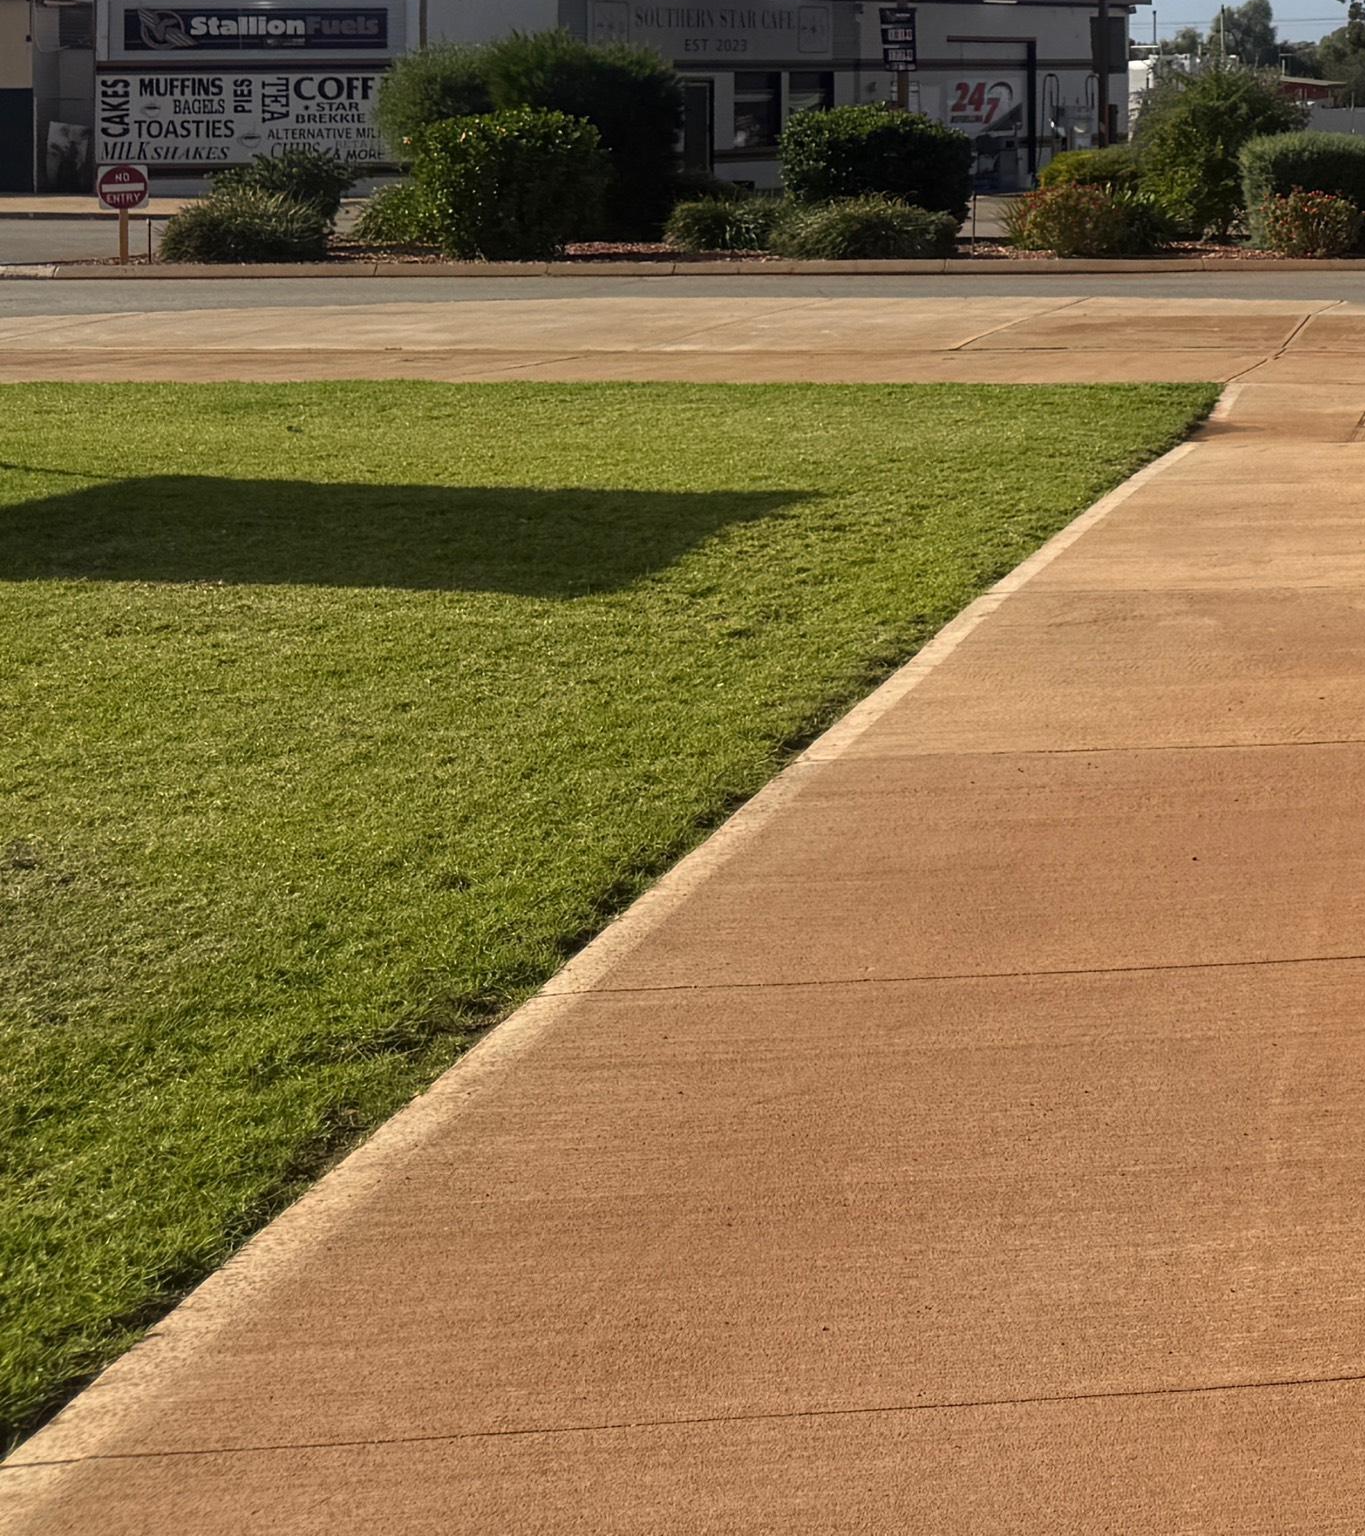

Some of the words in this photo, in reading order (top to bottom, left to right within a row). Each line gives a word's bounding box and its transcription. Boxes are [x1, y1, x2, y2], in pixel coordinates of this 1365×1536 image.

[635, 8, 714, 29] SOUTHERN
[720, 9, 756, 29] STAR
[762, 10, 796, 30] CAFE
[684, 38, 708, 52] EST
[716, 38, 747, 52] 2023
[140, 77, 223, 97] MUFFINS
[293, 77, 376, 100] COFF
[233, 79, 252, 114] PIES
[262, 77, 290, 124] TEA
[951, 82, 986, 112] 24
[101, 79, 130, 138] CAKES
[174, 99, 225, 114] BAGELS
[316, 102, 359, 112] STAR
[296, 113, 366, 124] BREKKIE
[134, 120, 235, 138] TOASTIES
[267, 128, 352, 140] ALTERNATIVE
[115, 172, 130, 183] NO
[106, 192, 141, 204] ENTRY
